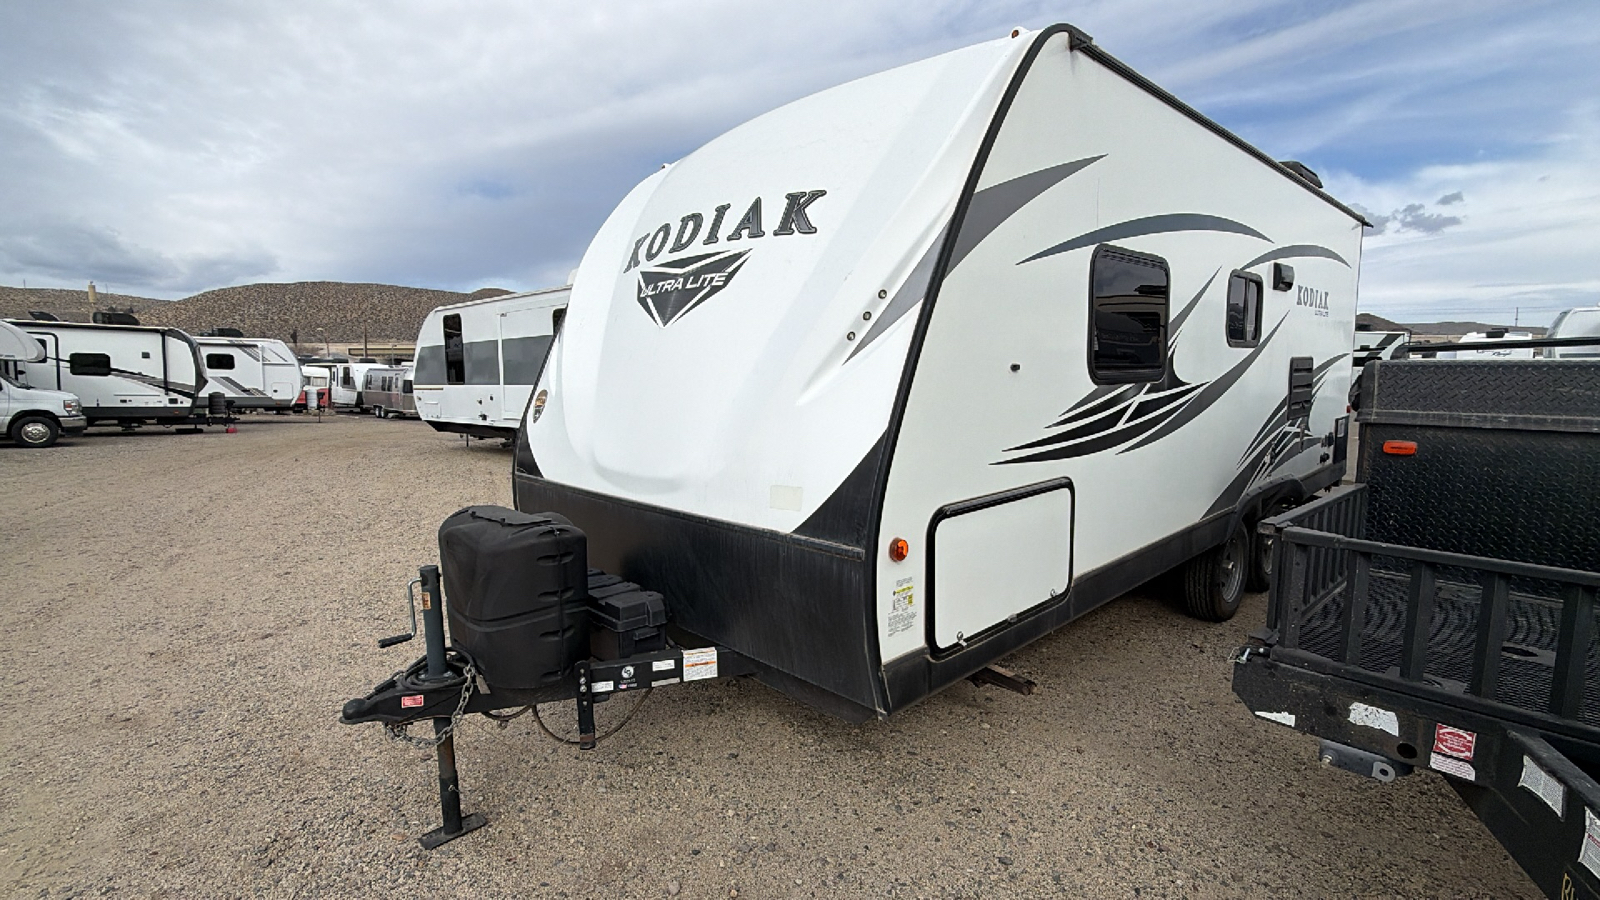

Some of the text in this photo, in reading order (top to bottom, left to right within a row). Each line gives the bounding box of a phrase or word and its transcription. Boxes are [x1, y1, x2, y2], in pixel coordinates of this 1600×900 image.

[623, 190, 827, 273] KODIAK
[640, 272, 729, 297] ULTRA LITE
[1296, 285, 1329, 310] KODIAK
